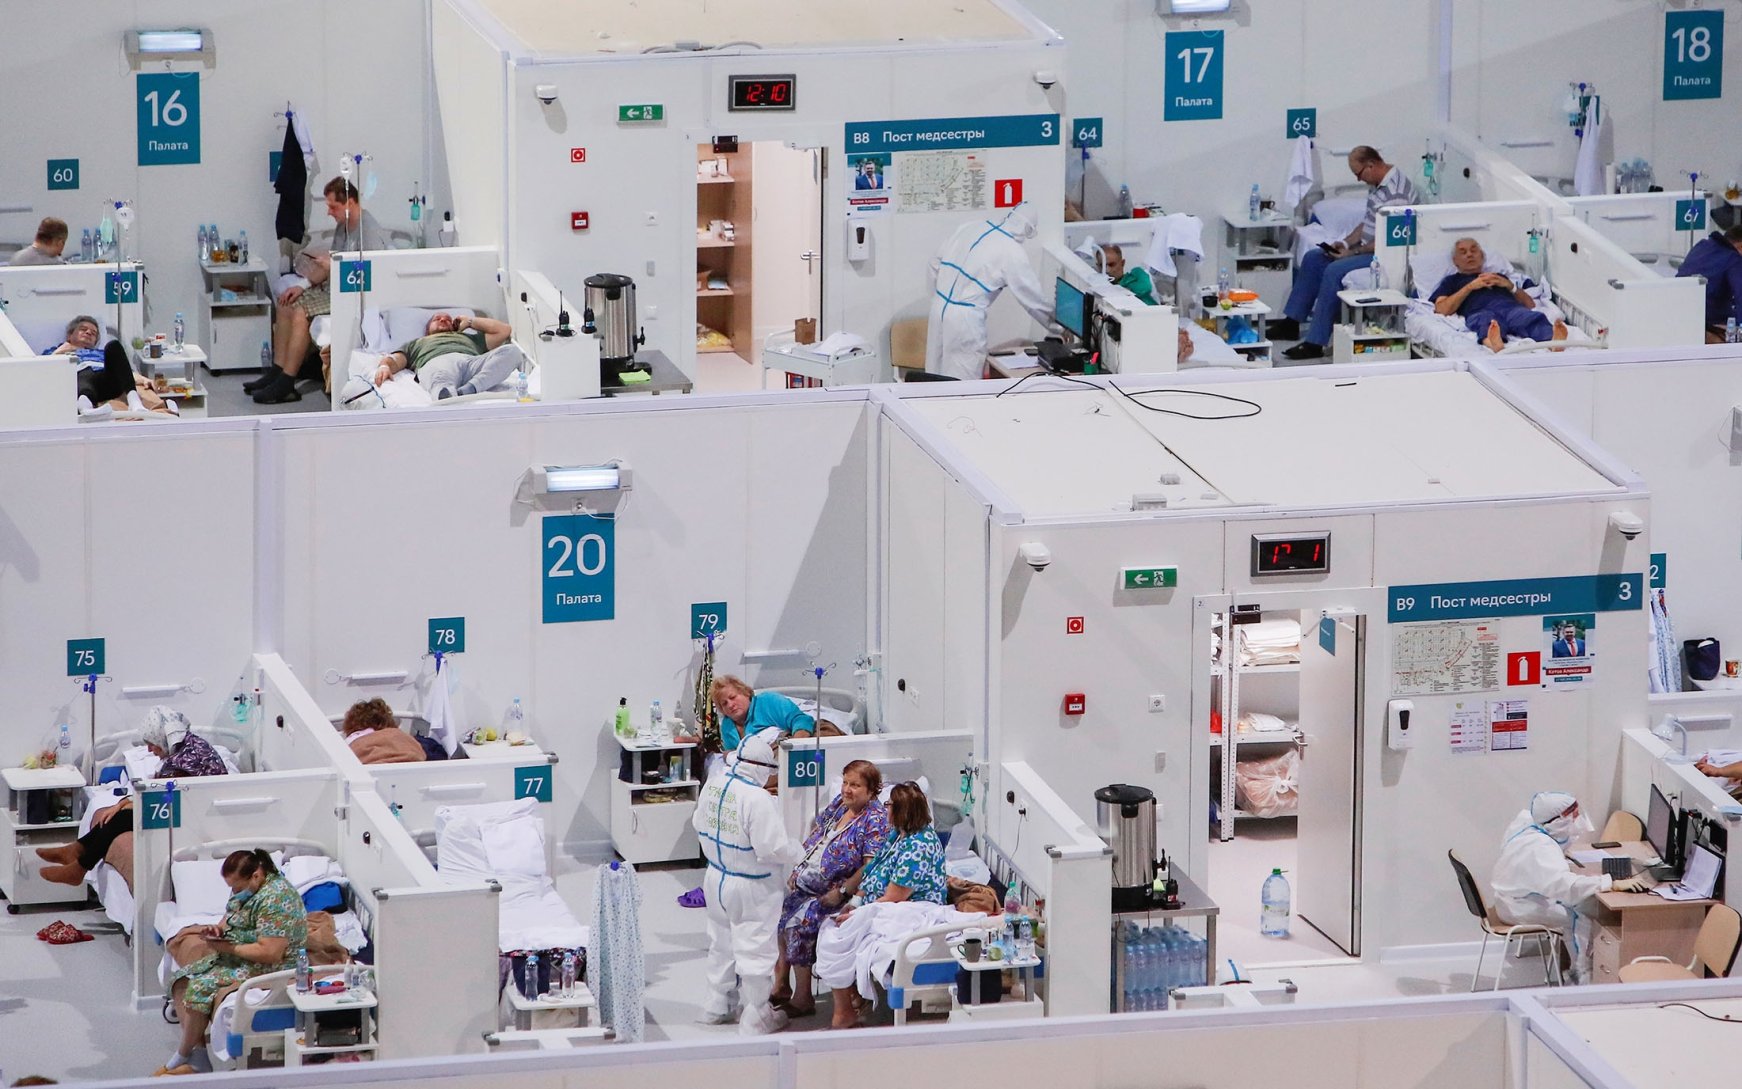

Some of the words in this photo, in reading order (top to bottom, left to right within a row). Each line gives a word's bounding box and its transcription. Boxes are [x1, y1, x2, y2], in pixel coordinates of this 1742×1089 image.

[1672, 26, 1711, 63] 18
[1177, 47, 1214, 83] 17
[1674, 75, 1711, 87] Палата
[746, 83, 788, 102] 12:10
[144, 89, 188, 127] 16
[1175, 96, 1213, 107] Палата
[882, 131, 913, 143] Пост
[916, 129, 985, 142] медсестры
[1041, 121, 1052, 138] 3
[1292, 117, 1311, 131] 65
[1078, 126, 1098, 141] 64
[148, 140, 189, 151] Палата
[53, 168, 73, 182] 60
[1392, 224, 1411, 238] 66
[113, 281, 131, 295] 59
[547, 533, 606, 578] 20
[556, 593, 602, 606] Палата
[1431, 595, 1466, 609] Пост
[1470, 592, 1551, 606] медсестры
[1618, 581, 1632, 601] 3
[698, 613, 719, 630] 79
[435, 629, 456, 645] 78
[74, 650, 95, 667] 75
[794, 761, 817, 778] 80
[523, 777, 544, 795] 77
[150, 802, 170, 820] 76
